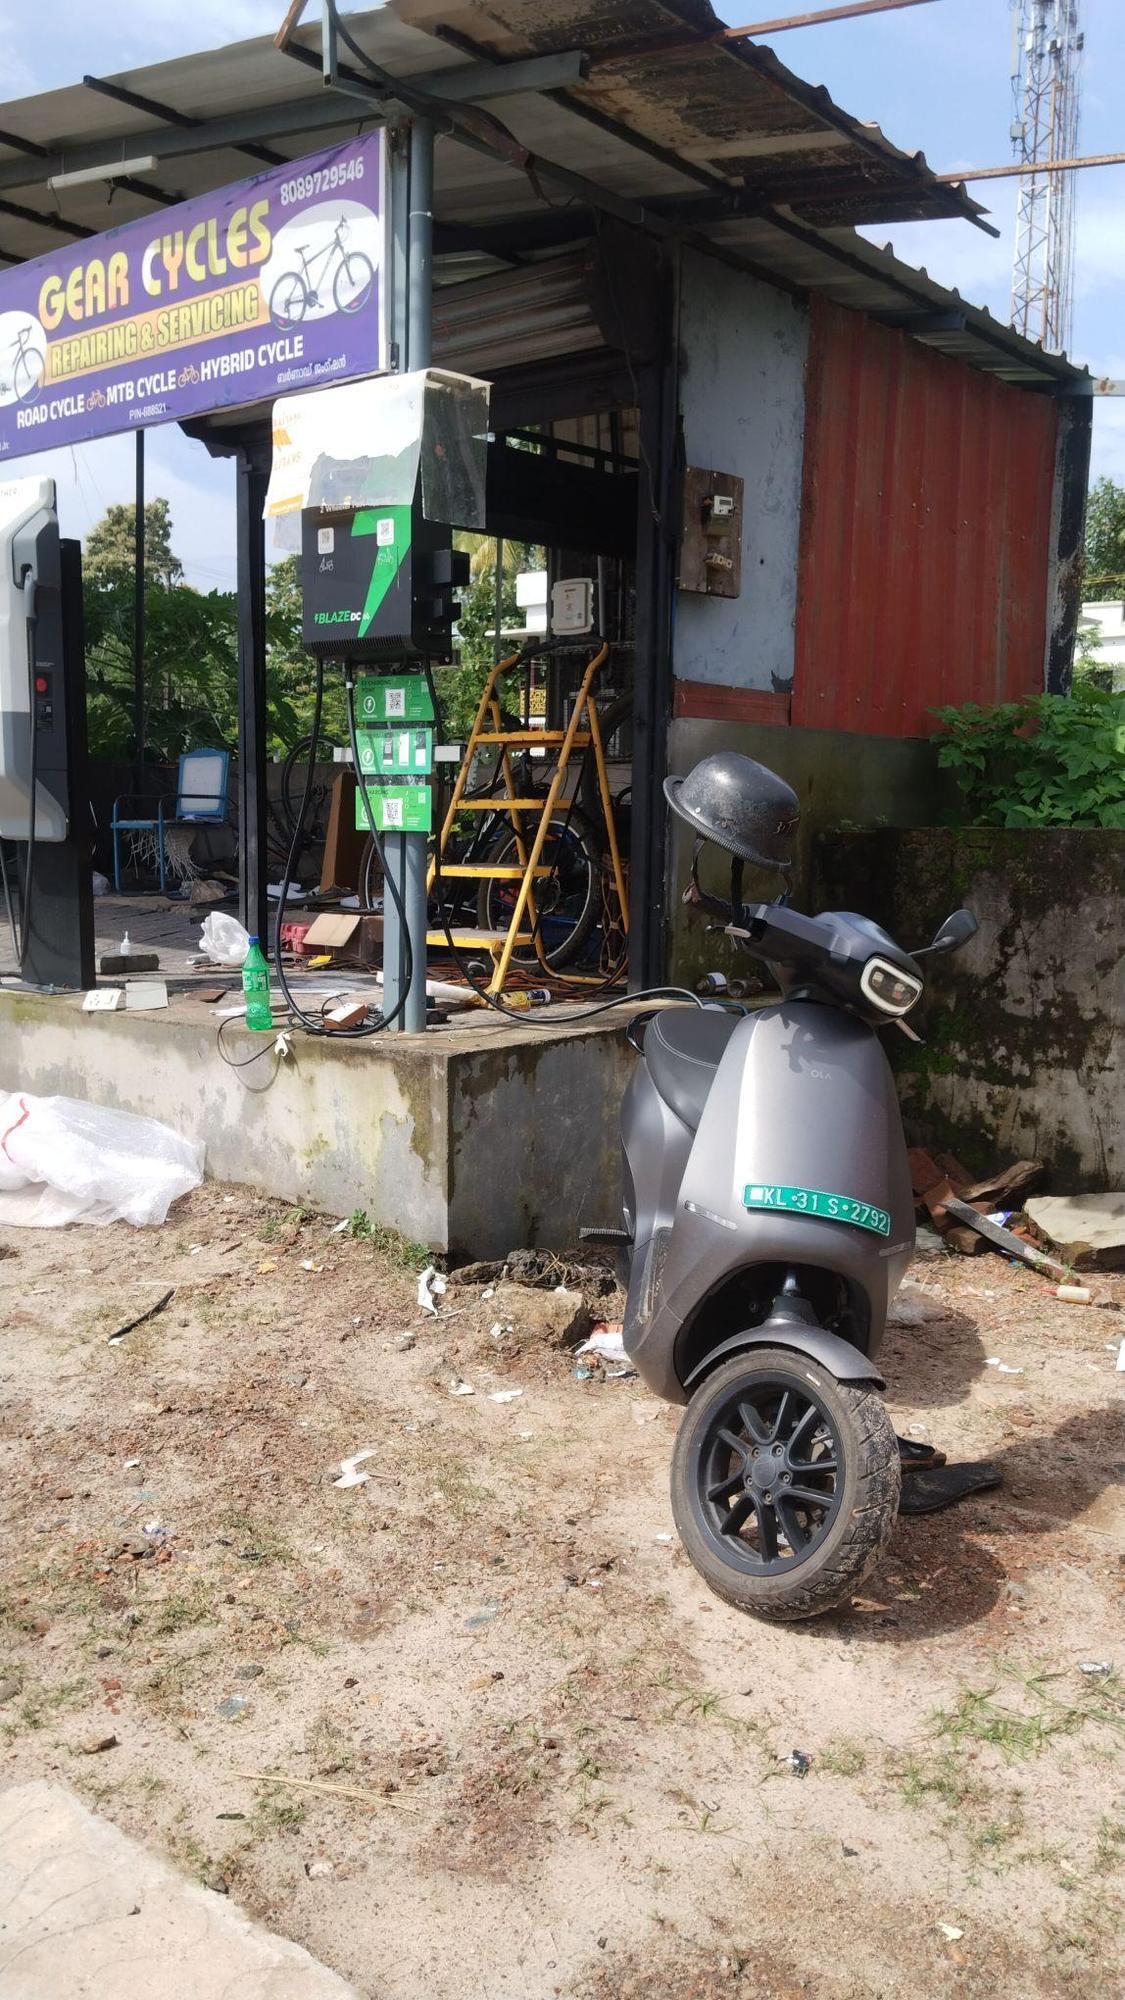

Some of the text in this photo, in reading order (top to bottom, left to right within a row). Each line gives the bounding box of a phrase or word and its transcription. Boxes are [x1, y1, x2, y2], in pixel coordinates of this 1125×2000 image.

[280, 156, 364, 206] 8089729546
[38, 199, 272, 331] GEAR CYCLES
[50, 284, 259, 379] REPAIRING & SERVICING
[16, 335, 304, 429] ROAD CYCLE MTB CYCLE HYBRID CYCLE
[810, 1069, 832, 1080] OLA
[763, 1187, 787, 1206] KL
[850, 1203, 887, 1231] 2792
